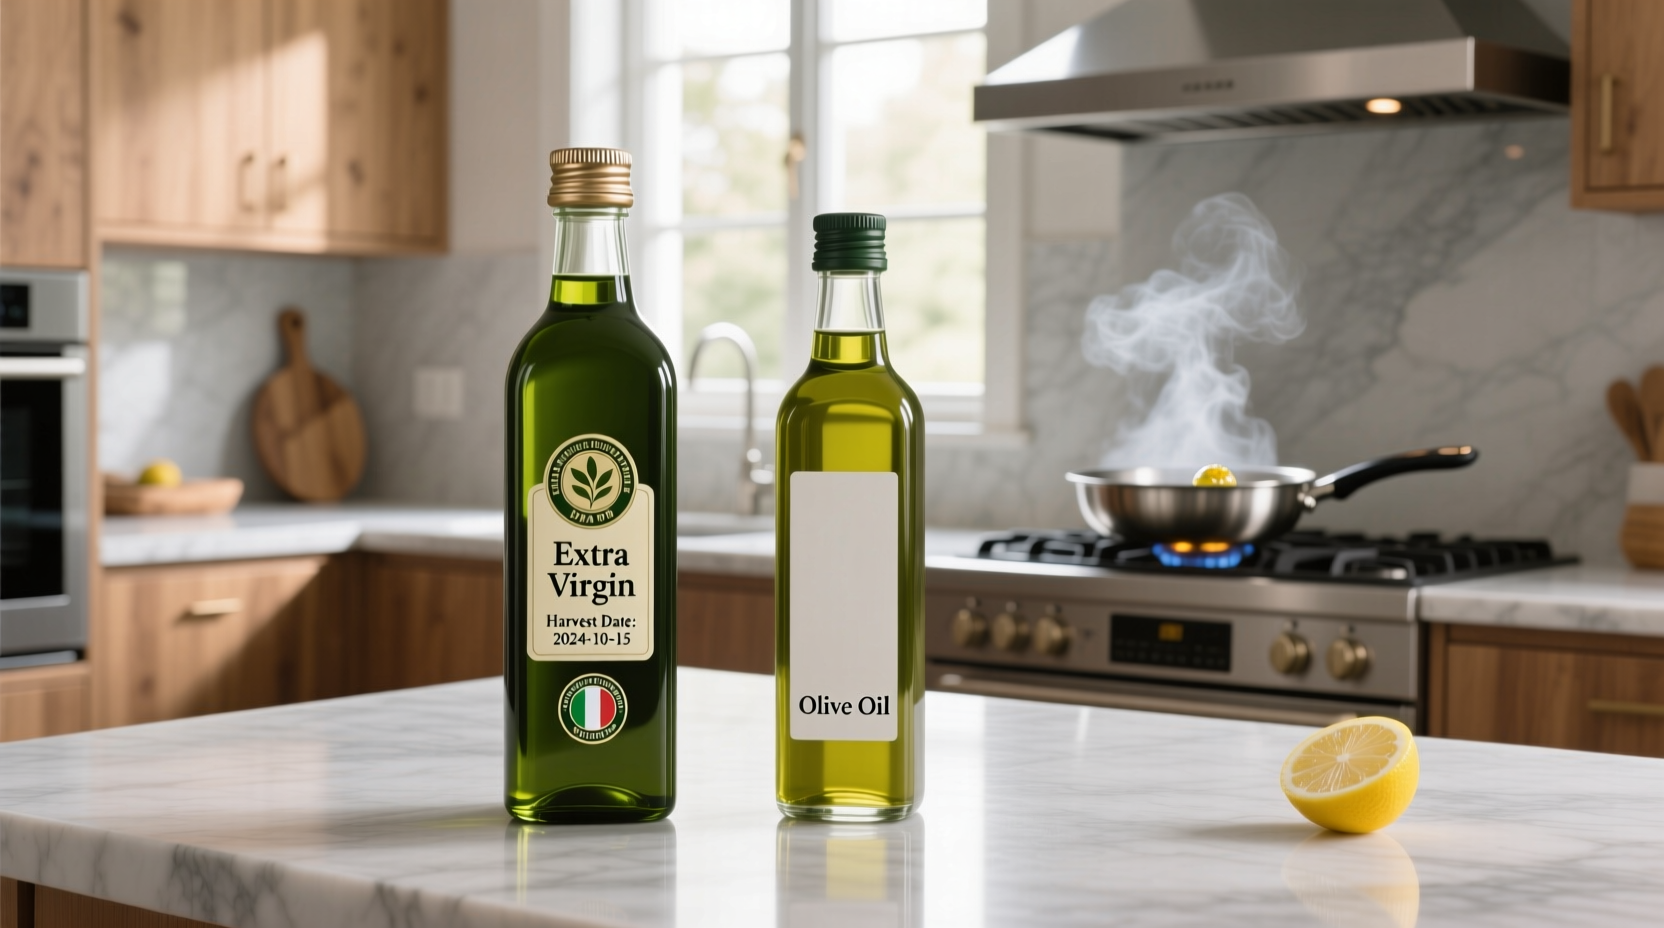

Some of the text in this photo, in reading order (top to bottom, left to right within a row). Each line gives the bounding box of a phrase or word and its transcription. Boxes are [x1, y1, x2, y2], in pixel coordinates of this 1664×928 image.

[553, 540, 630, 567] Extra
[547, 572, 637, 606] Virgin
[546, 614, 636, 628] Harvest Date:
[553, 631, 631, 646] 2024-10-15
[798, 695, 890, 716] Olive Oil
